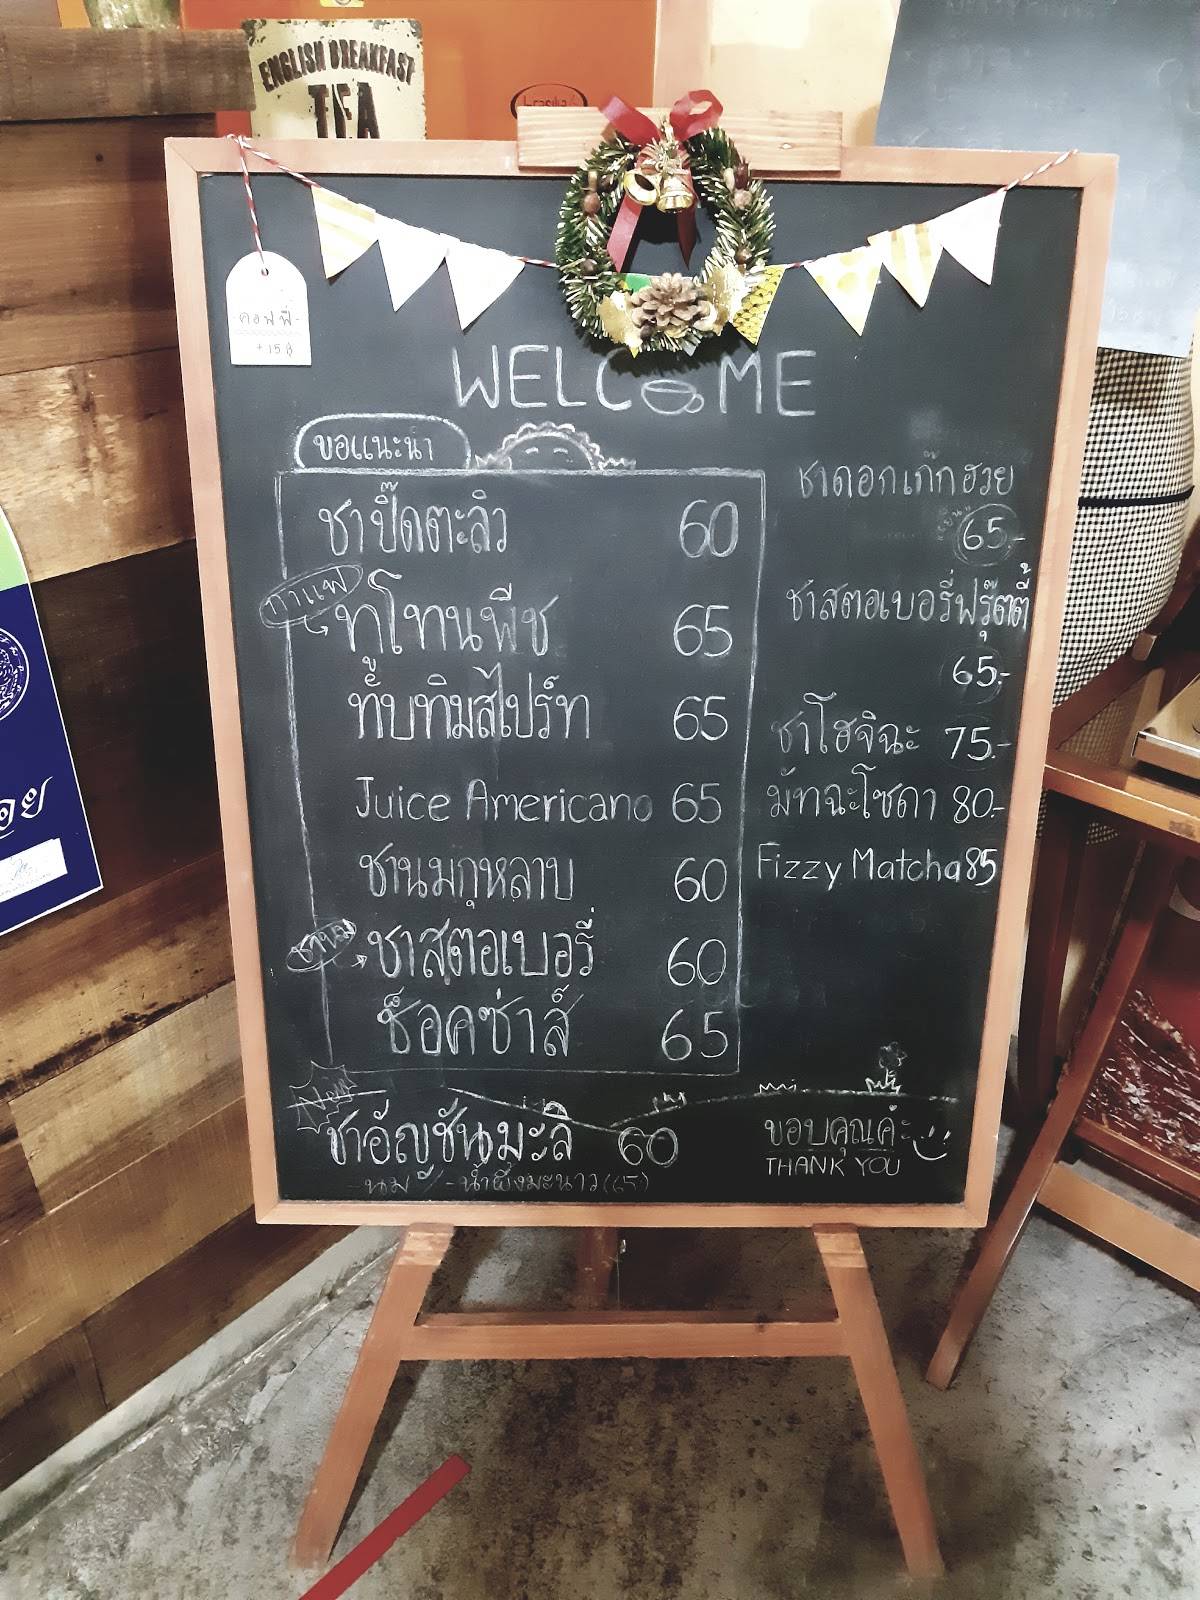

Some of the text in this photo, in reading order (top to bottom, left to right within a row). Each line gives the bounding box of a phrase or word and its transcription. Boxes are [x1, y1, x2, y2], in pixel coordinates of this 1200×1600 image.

[258, 38, 416, 93] ENGLISH BREAKFAST
[679, 499, 739, 559] 60
[264, 566, 348, 616] กาแฟ
[673, 604, 734, 658] 65
[673, 695, 729, 741] 65
[355, 776, 723, 824] Juice Americano 65
[359, 842, 729, 909] ชานมกุหลาบ 60
[758, 841, 998, 891] Fizzy Matcha 85
[666, 936, 727, 986] 60
[661, 1008, 729, 1061] 65
[618, 1126, 679, 1168] 60
[765, 1155, 901, 1177] THANK YOU
